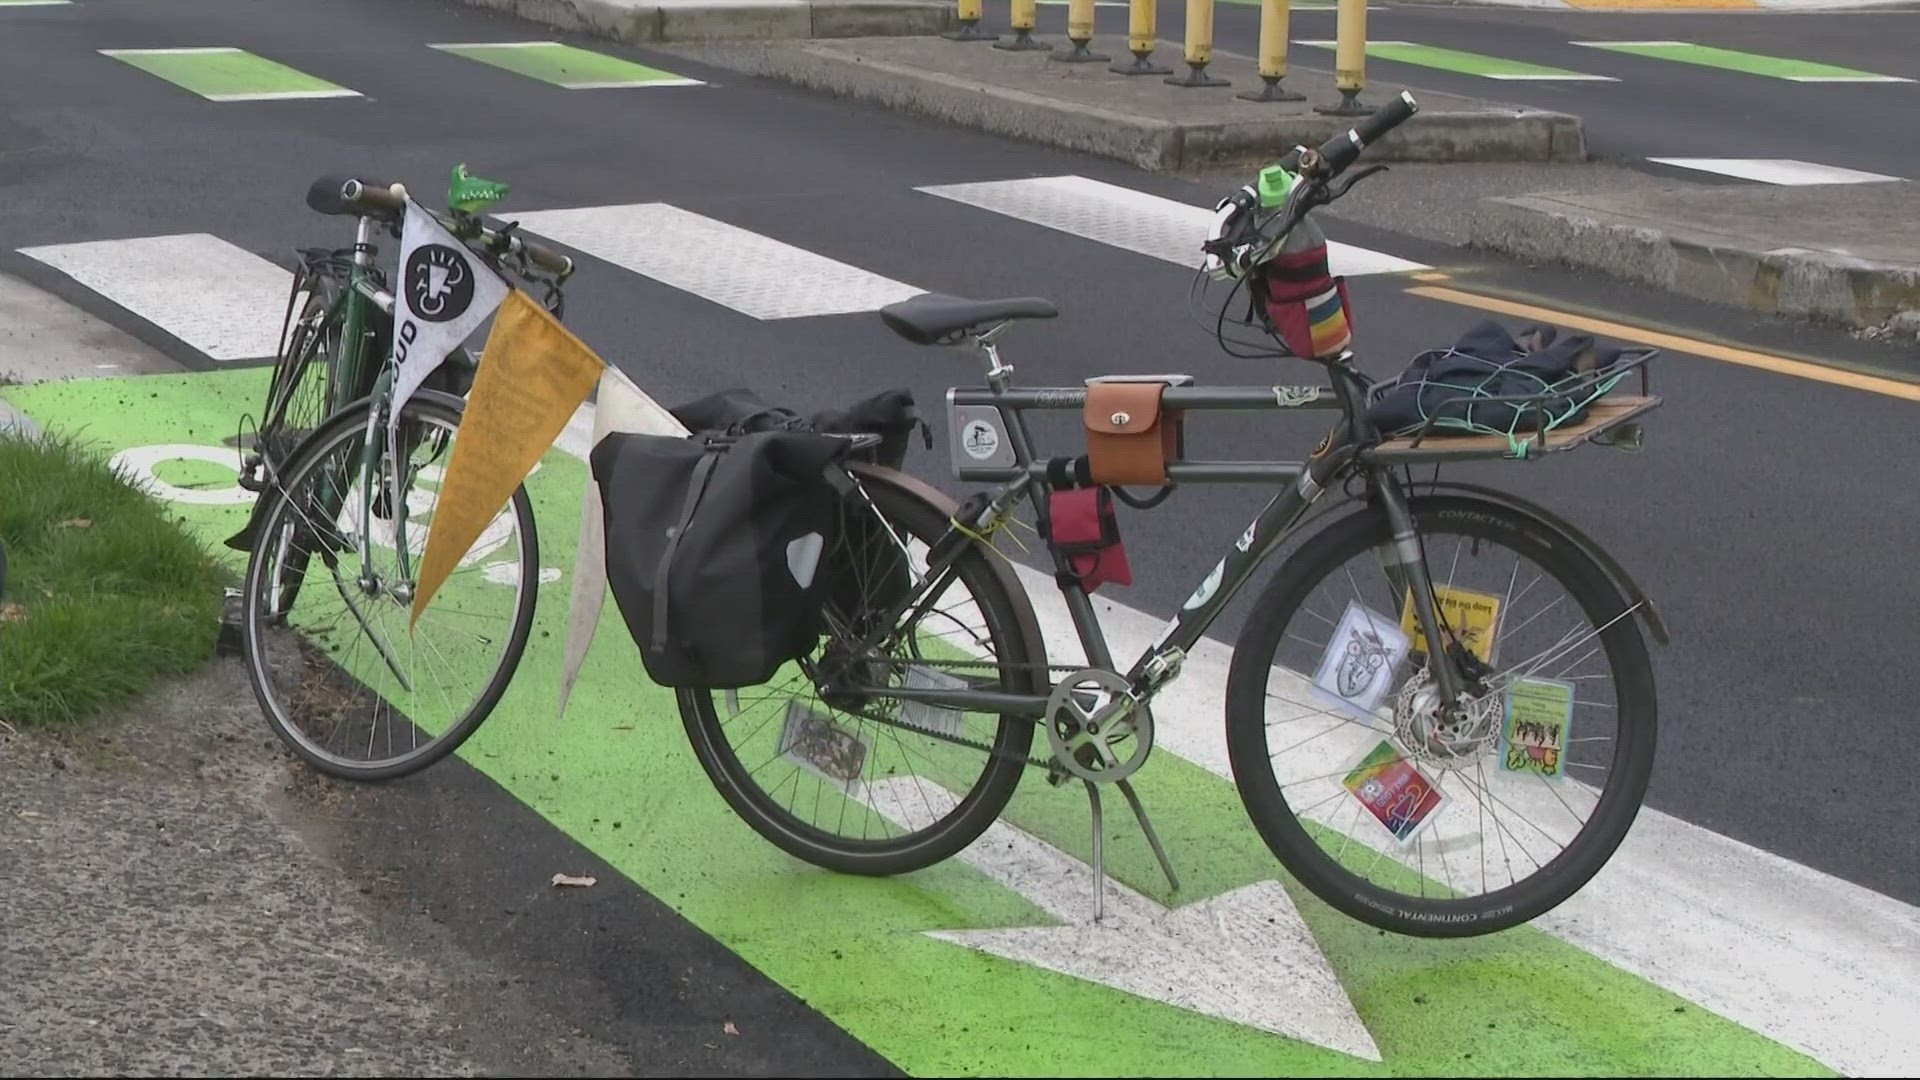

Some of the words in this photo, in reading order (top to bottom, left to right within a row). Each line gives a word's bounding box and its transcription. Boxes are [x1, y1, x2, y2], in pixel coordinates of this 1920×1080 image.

[394, 320, 417, 386] OUD
[1472, 601, 1491, 614] Loop
[1399, 909, 1478, 923] CONTINENTAL
